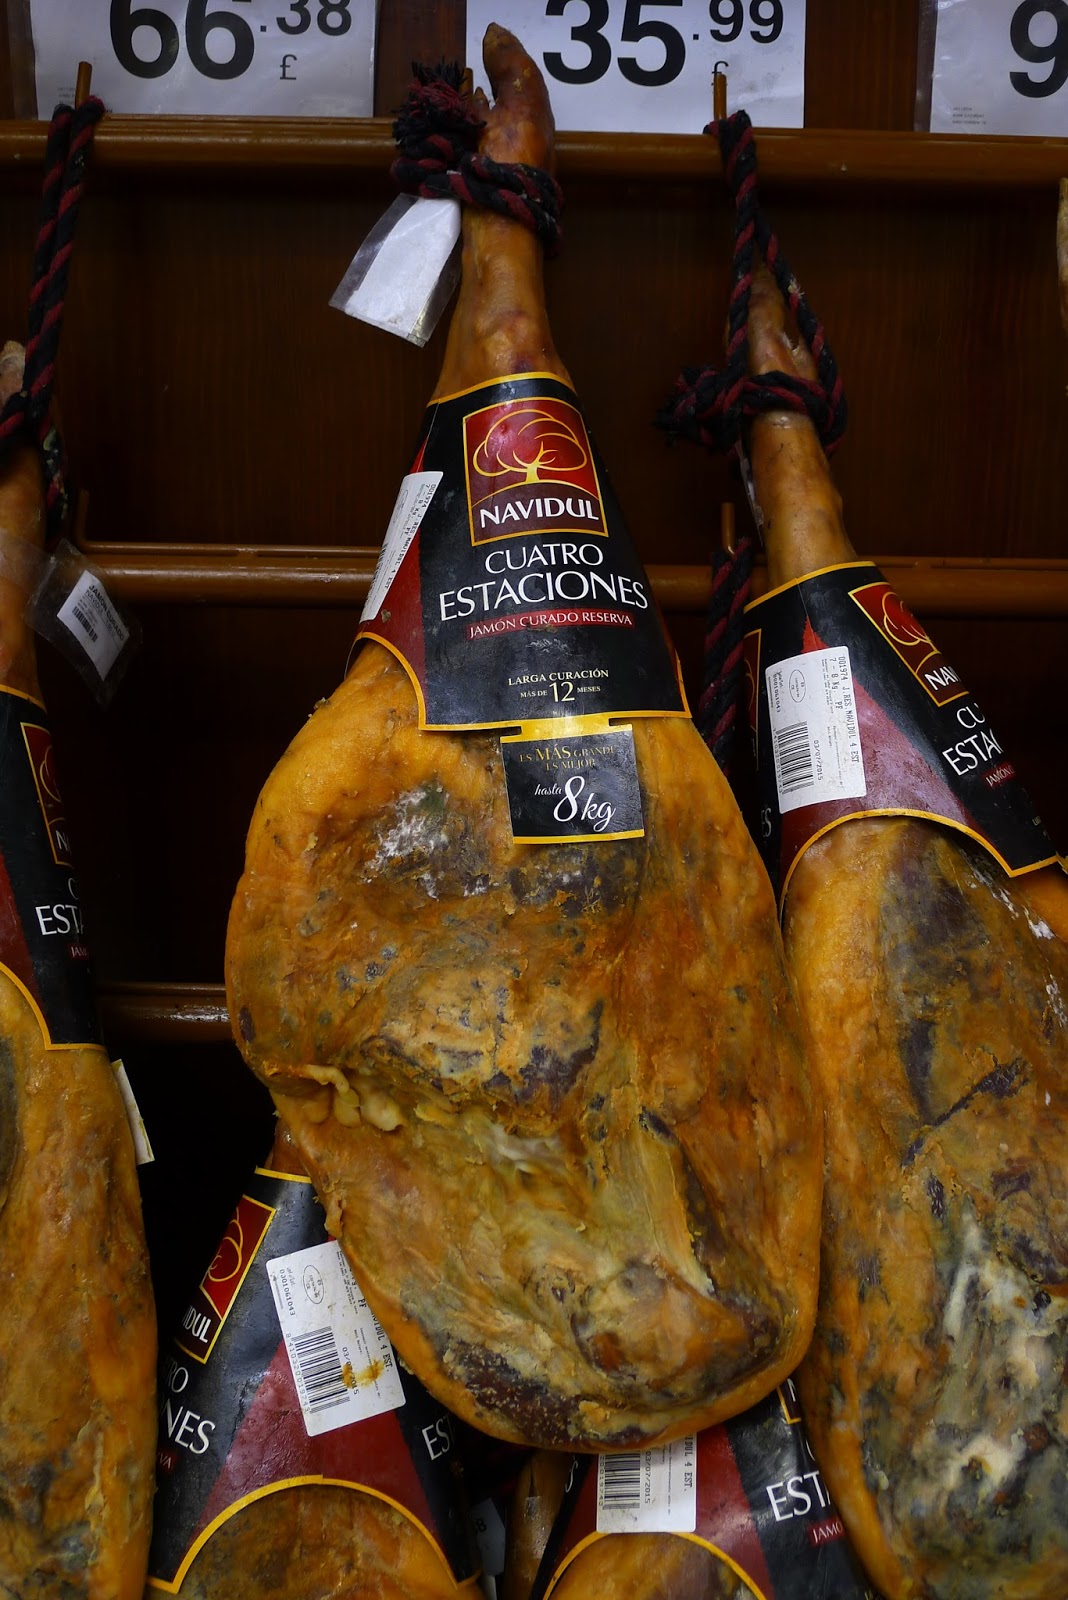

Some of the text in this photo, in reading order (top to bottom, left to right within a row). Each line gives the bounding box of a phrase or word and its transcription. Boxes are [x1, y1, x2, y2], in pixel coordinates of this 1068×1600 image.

[279, 54, 297, 80] £
[480, 497, 599, 528] NAVIDUL
[485, 543, 604, 574] CUATRO
[439, 570, 649, 621] ESTACIONES
[469, 612, 633, 638] JAMÓN CURADO RESERVA
[508, 668, 609, 686] LARGA CURACIÓN
[838, 656, 849, 681] 001974
[520, 689, 537, 698] MÁS
[549, 681, 576, 703] 12
[577, 685, 601, 693] MESES
[535, 744, 572, 761] MÁS
[813, 740, 823, 781] 03/07/2015
[534, 783, 562, 796] hasta
[357, 1298, 367, 1308] PF
[644, 1451, 652, 1504] 03/07/2015
[683, 1472, 692, 1492] EST.
